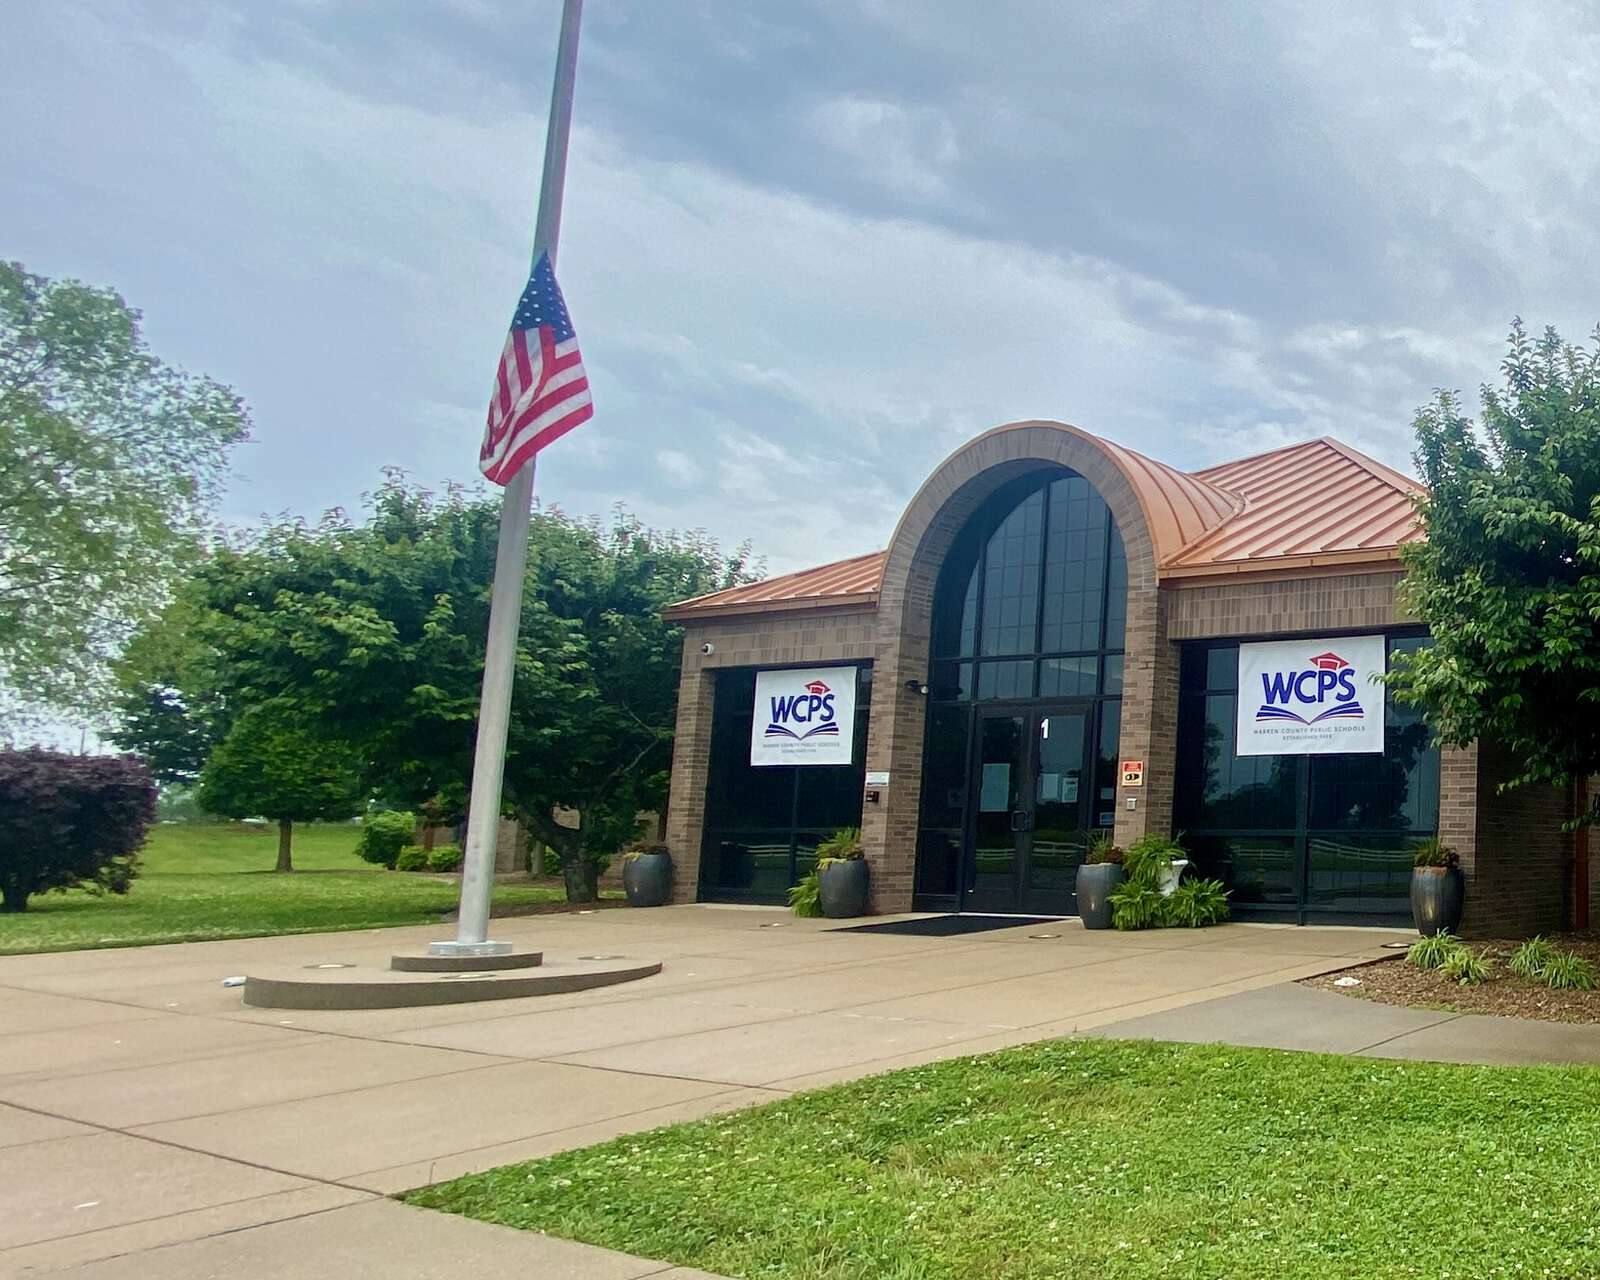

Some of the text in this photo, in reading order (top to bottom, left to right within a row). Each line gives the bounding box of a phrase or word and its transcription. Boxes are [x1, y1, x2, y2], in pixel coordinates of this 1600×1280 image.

[1262, 668, 1356, 705] WCPS
[771, 694, 835, 723] WCPS
[1041, 718, 1049, 739] 1
